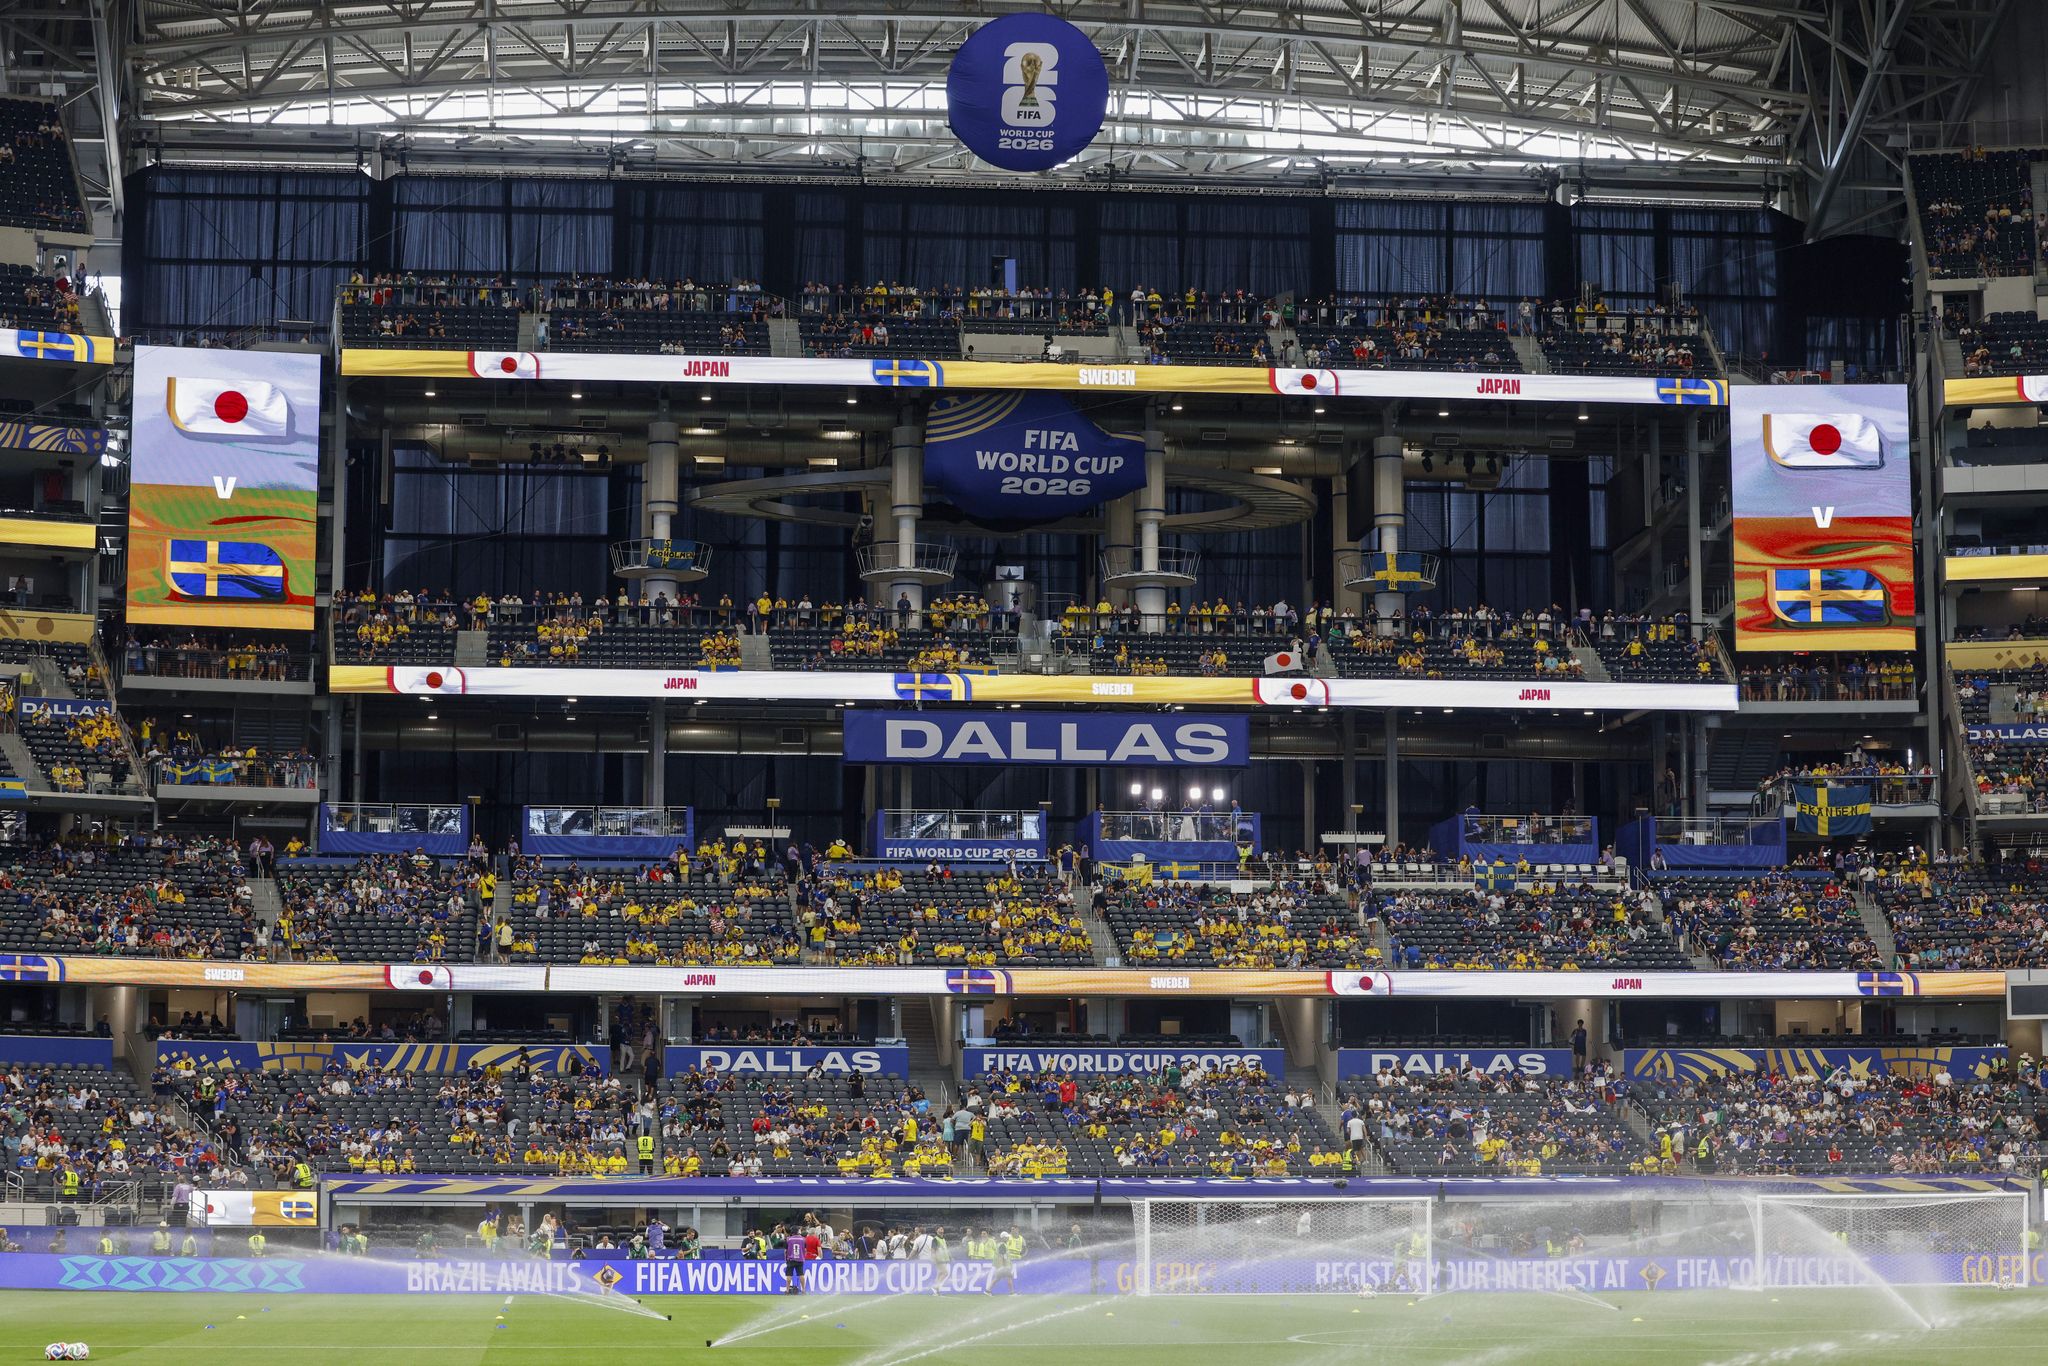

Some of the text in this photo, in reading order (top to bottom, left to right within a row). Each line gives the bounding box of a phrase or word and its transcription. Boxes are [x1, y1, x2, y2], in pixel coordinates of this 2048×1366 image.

[1016, 110, 1042, 120] FIFA
[1000, 129, 1055, 138] WORLD CUP
[998, 138, 1054, 151] 2026
[684, 361, 730, 377] JAPAN
[1079, 368, 1136, 386] SWEDEN
[1477, 378, 1521, 395] JAPAN
[1024, 429, 1080, 452] FIFA
[975, 450, 1125, 475] WORLD CUP
[1000, 476, 1092, 496] 2026
[664, 677, 697, 690] JAPAN
[1092, 683, 1134, 696] SWEDEN
[1519, 689, 1551, 701] JAPAN
[885, 719, 1230, 763] DALLAS
[1968, 727, 2048, 740] DALLAS
[885, 847, 1038, 858] FIFA WORLD CUP 2026
[204, 968, 244, 981] SWEDEN
[684, 974, 716, 986] JAPAN
[1151, 976, 1190, 989] SWEDEN
[1612, 978, 1642, 990] JAPAN
[700, 1050, 881, 1073] DALLAS
[983, 1053, 1035, 1072] FIFA
[1038, 1053, 1124, 1072] WORLD
[1129, 1053, 1177, 1073] CUP
[1371, 1053, 1547, 1075] DALLAS
[407, 1262, 582, 1292] BRAZIL AWAITS
[636, 1262, 996, 1292] FIFA WOMEN'S WORLD CUP 2027
[1116, 1262, 1147, 1291] GO
[1315, 1262, 1423, 1291] REGISTR
[1495, 1260, 1599, 1290] INTEREST
[1604, 1260, 1630, 1289] AT
[1962, 1255, 2045, 1285] GO EPC
